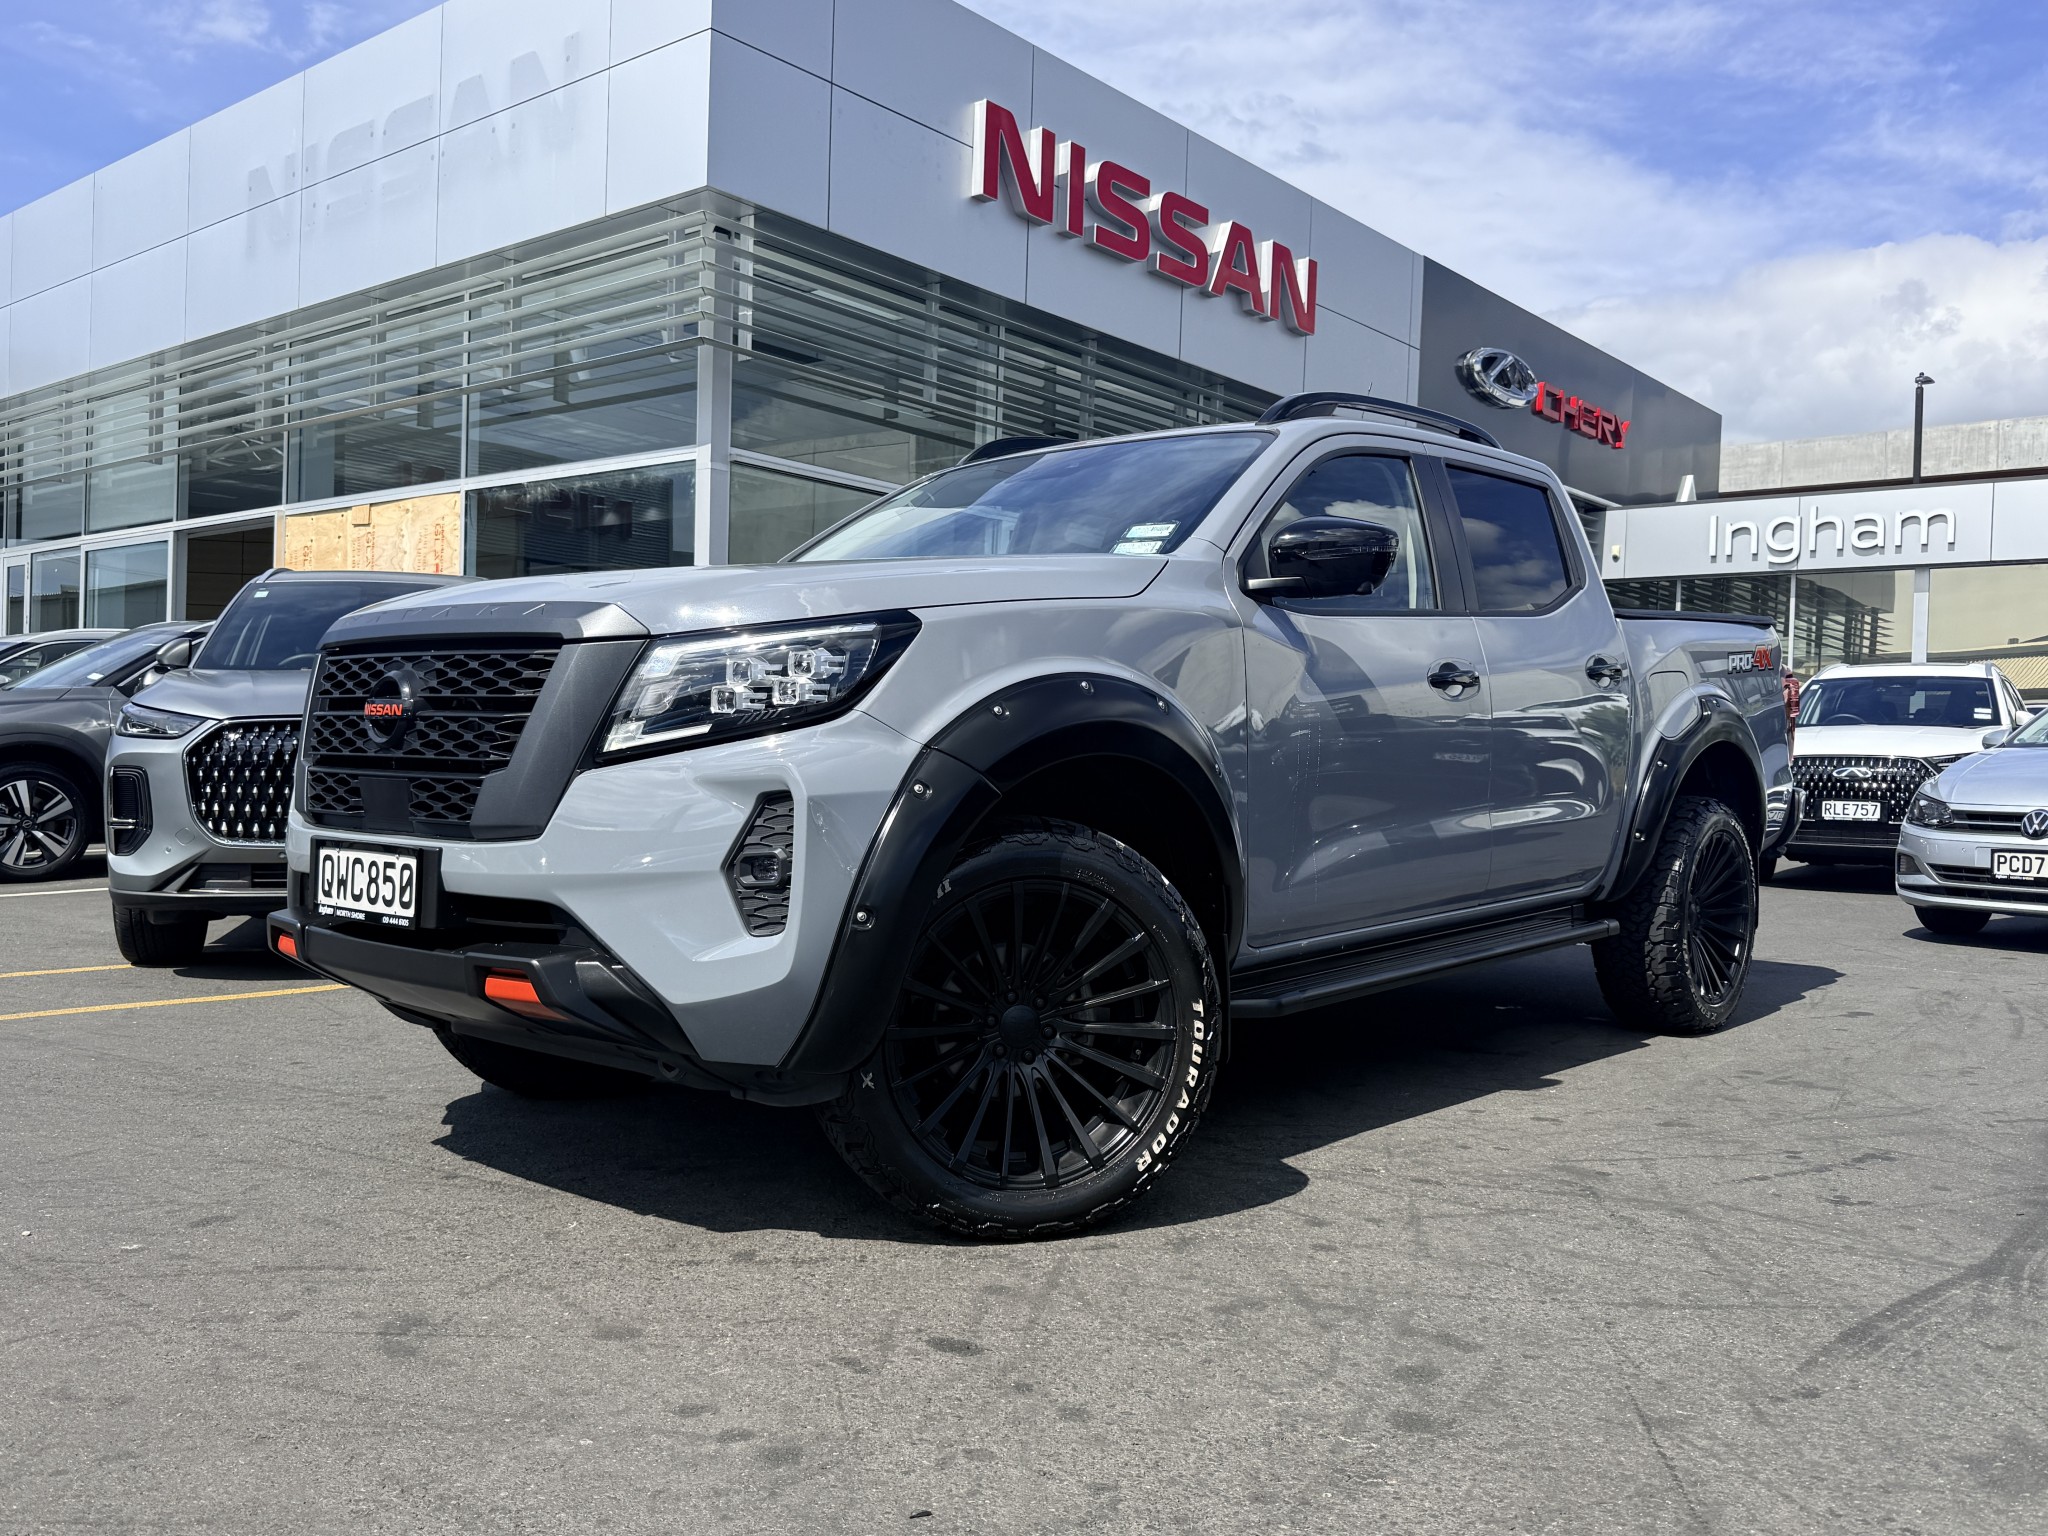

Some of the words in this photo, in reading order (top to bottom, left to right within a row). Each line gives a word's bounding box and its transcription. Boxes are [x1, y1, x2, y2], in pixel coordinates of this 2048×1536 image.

[973, 98, 1318, 336] NISSAN
[1536, 382, 1630, 448] CHERY
[1709, 506, 1956, 564] Ingham
[364, 703, 403, 716] NISSAN
[1823, 802, 1879, 817] RLE757
[321, 853, 414, 910] QWC850
[1996, 854, 2046, 875] PCD7
[1134, 998, 1205, 1172] TOURADOR
